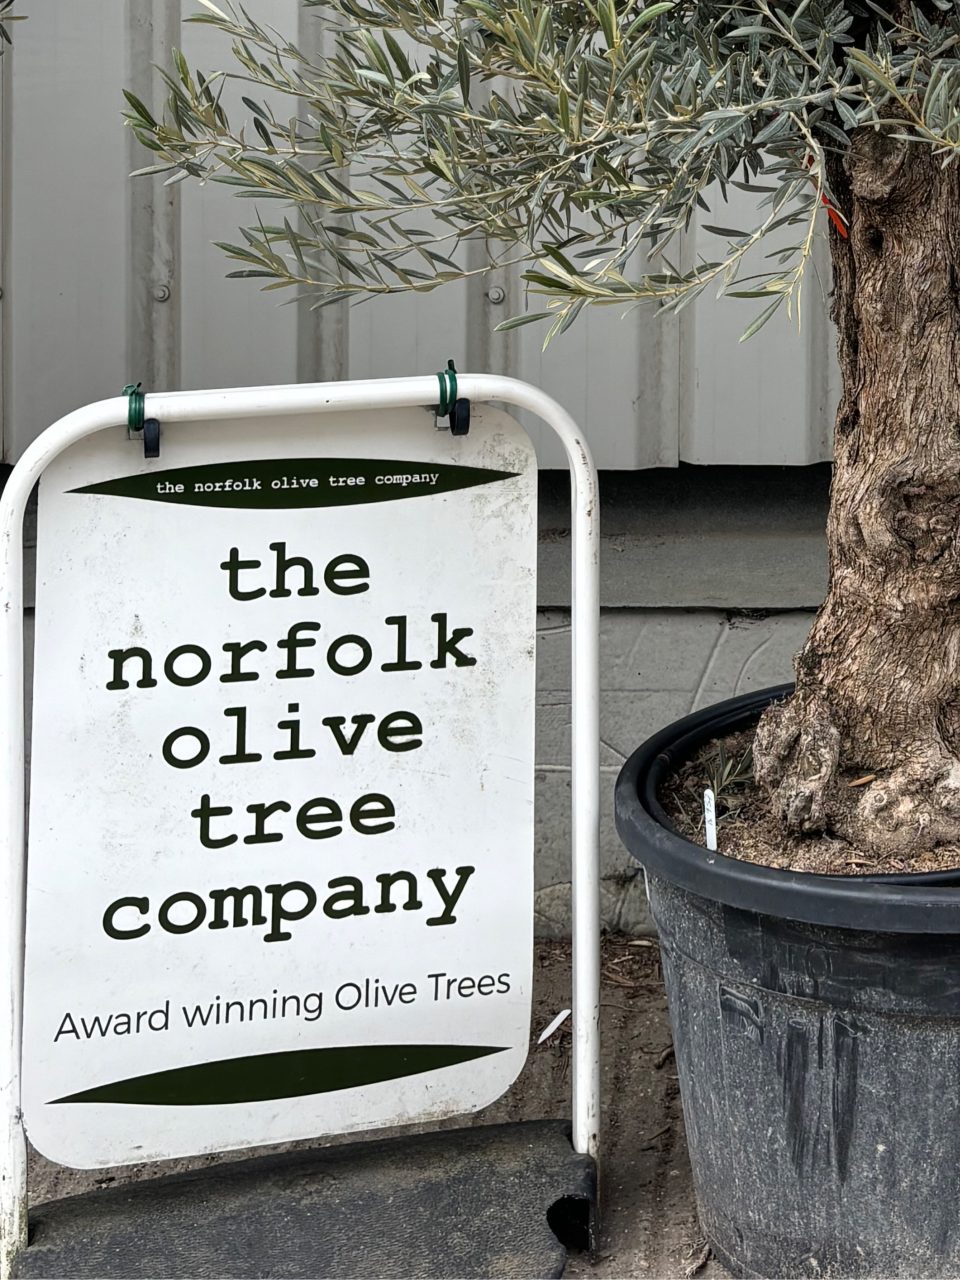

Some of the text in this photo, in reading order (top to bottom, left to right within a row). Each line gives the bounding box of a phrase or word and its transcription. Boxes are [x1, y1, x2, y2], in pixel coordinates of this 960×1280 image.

[156, 471, 440, 494] the norfolk olive tree company
[220, 542, 370, 601] the
[106, 613, 477, 690] norfolk
[162, 703, 423, 769] olive
[191, 792, 396, 849] tree
[102, 865, 475, 942] company
[53, 971, 511, 1043] Award winning Olive Trees
